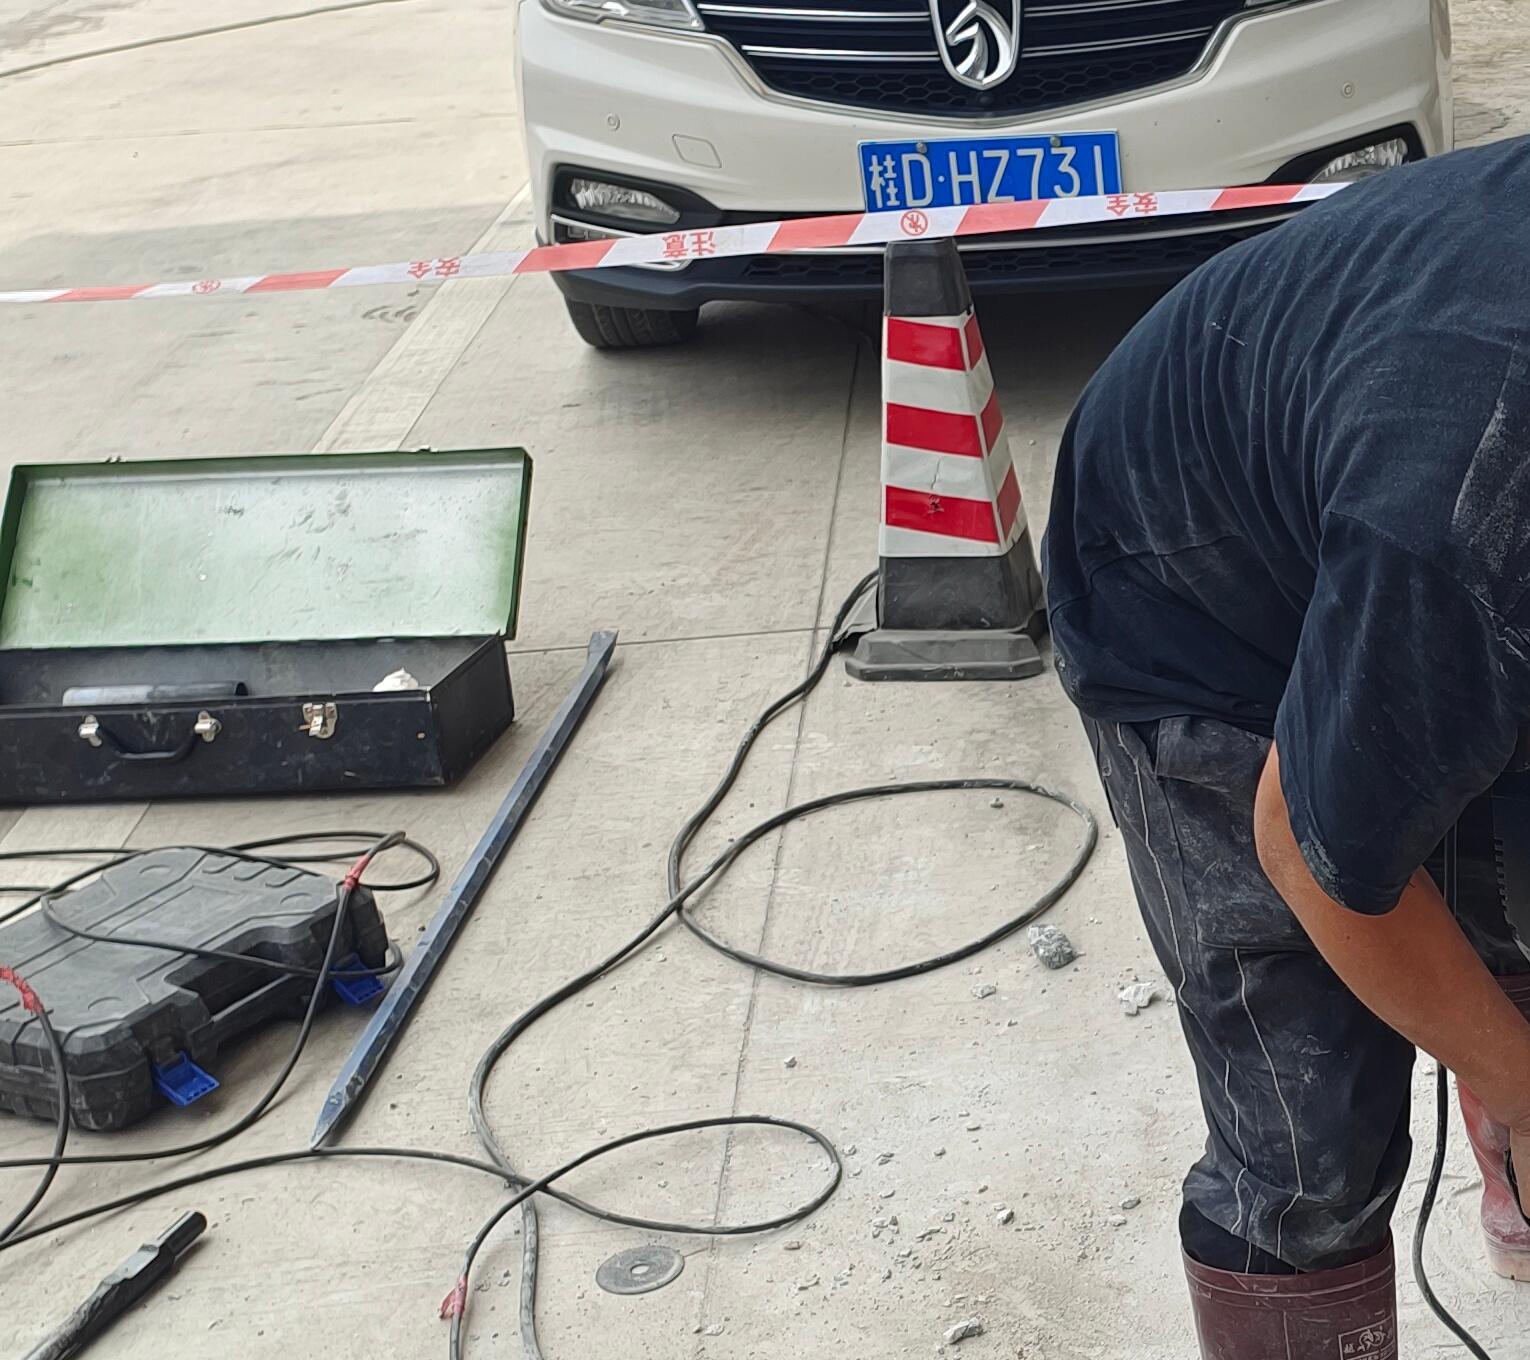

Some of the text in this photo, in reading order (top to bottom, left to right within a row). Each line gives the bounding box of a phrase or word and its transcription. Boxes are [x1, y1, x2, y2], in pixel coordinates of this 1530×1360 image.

[1106, 192, 1158, 216] 安全
[662, 231, 716, 257] 注意
[407, 256, 460, 279] 安全
